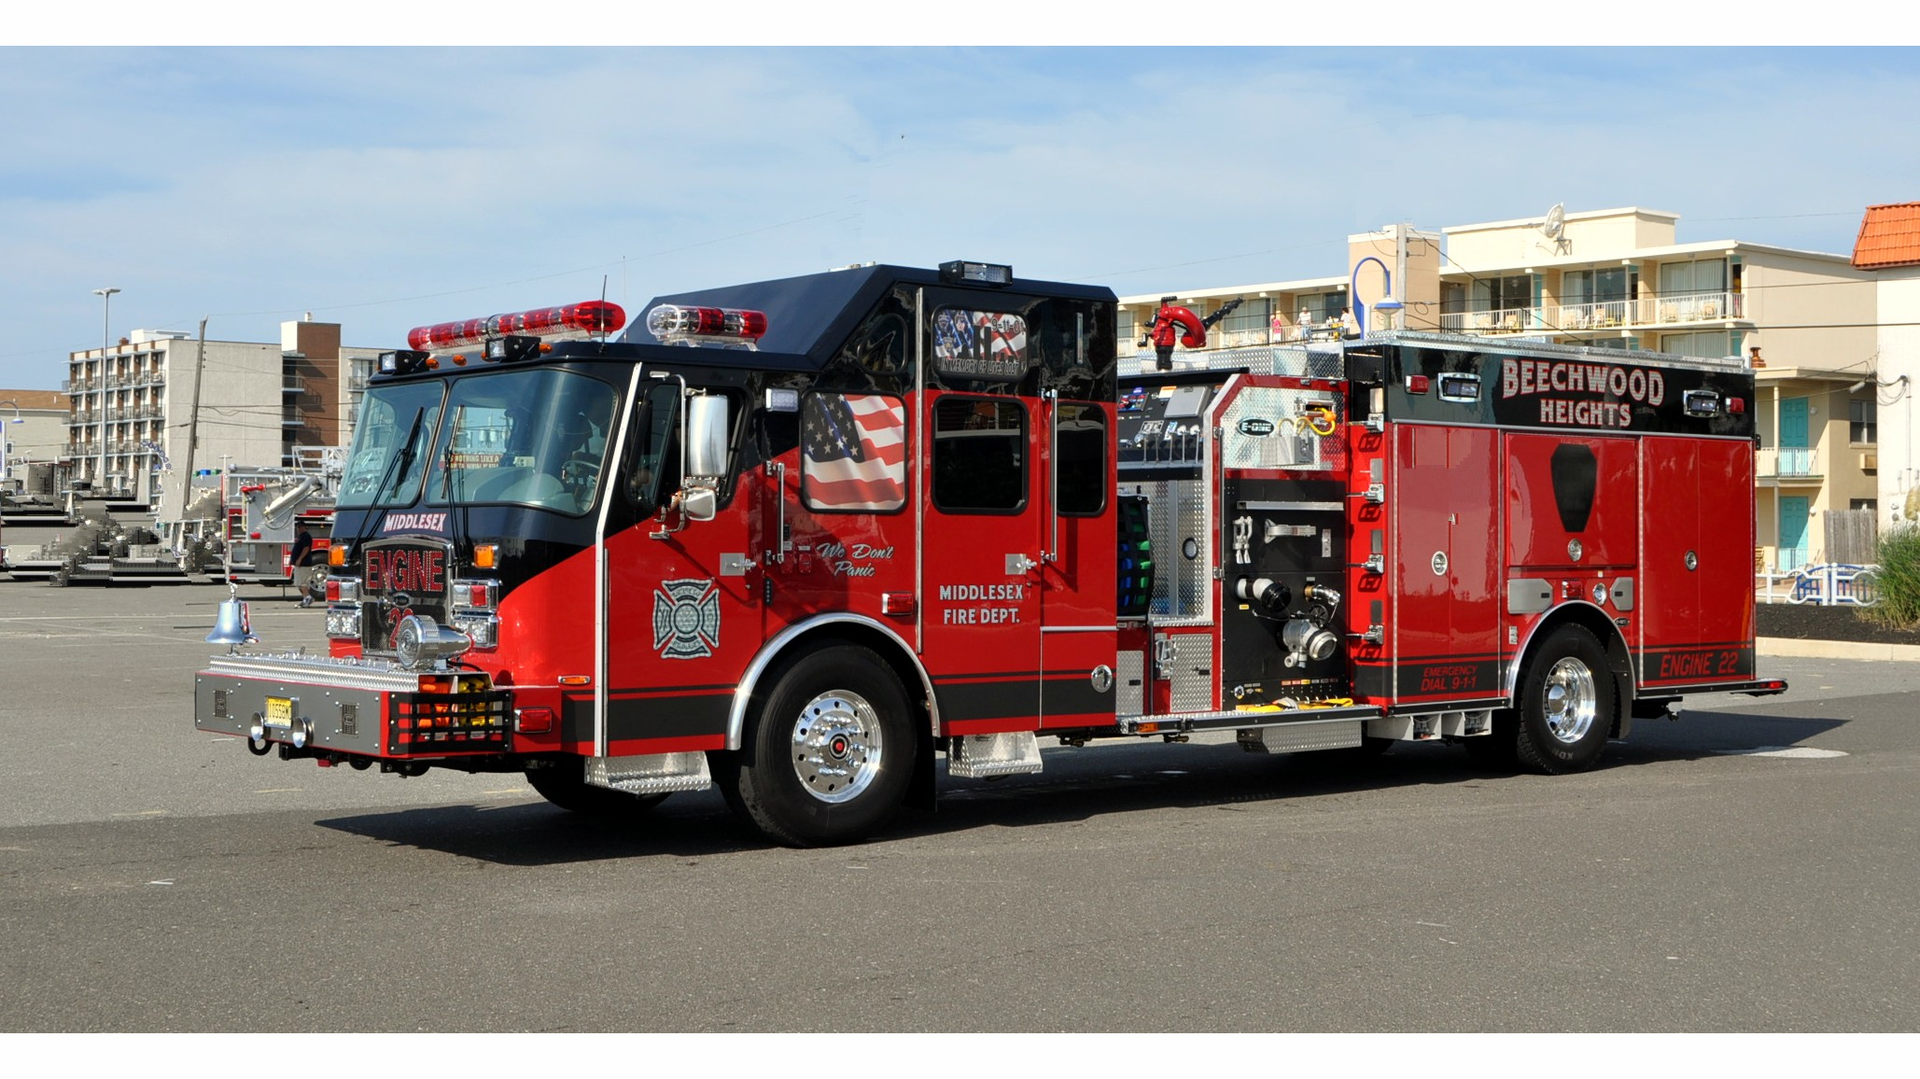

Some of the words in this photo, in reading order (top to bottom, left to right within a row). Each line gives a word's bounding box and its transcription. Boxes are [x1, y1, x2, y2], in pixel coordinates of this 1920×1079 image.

[1503, 359, 1664, 406] BEECHWOOD
[1540, 399, 1632, 427] HEIGHTS
[1241, 421, 1272, 432] E-ONE
[383, 513, 447, 532] MIDDLESEX
[816, 542, 846, 558] We
[852, 543, 894, 559] Don't
[366, 550, 444, 591] ENGINE
[834, 560, 876, 577] Panic
[940, 585, 1023, 600] MIDDLESEX
[944, 609, 976, 624] FIRE
[980, 608, 1020, 623] DEPT.
[388, 608, 414, 649] 2
[1423, 664, 1478, 678] EMERGENCY
[1660, 653, 1713, 677] ENGINE
[1718, 651, 1739, 674] 22
[1421, 678, 1447, 691] DIAL
[1451, 676, 1477, 690] 9-1-1
